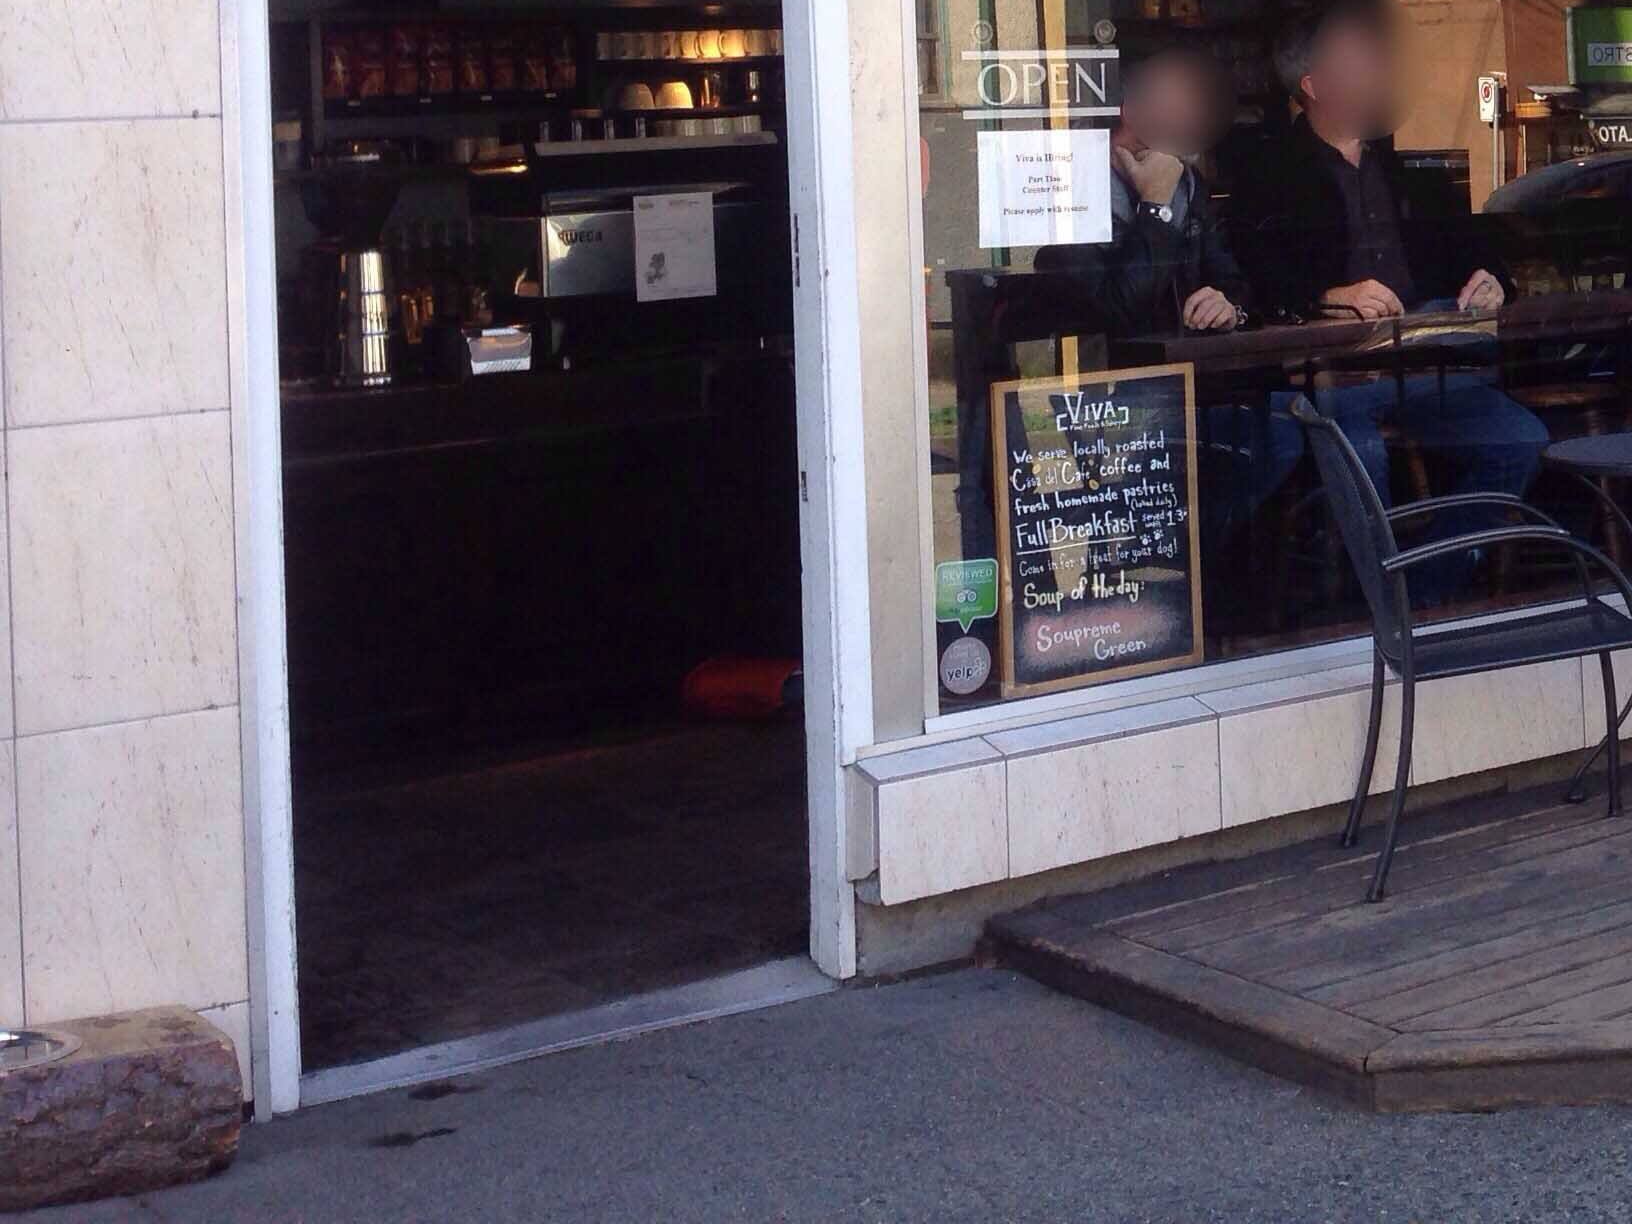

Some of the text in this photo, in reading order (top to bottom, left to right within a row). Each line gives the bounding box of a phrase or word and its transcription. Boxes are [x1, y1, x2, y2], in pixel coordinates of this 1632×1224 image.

[976, 62, 1106, 106] OPEN
[1013, 430, 1164, 464] We serve locally roasted
[1100, 457, 1142, 476] coffee
[1150, 452, 1170, 470] and
[1015, 478, 1175, 516] fresh homemade pastries
[1016, 520, 1048, 548] Full
[1050, 510, 1138, 544] Breakfast
[1116, 542, 1130, 560] for
[1024, 582, 1064, 611] Soup
[1071, 576, 1088, 600] of
[1092, 573, 1115, 599] the
[1037, 621, 1121, 652] Soupreme
[1094, 638, 1146, 660] Green
[946, 665, 974, 682] yelp
